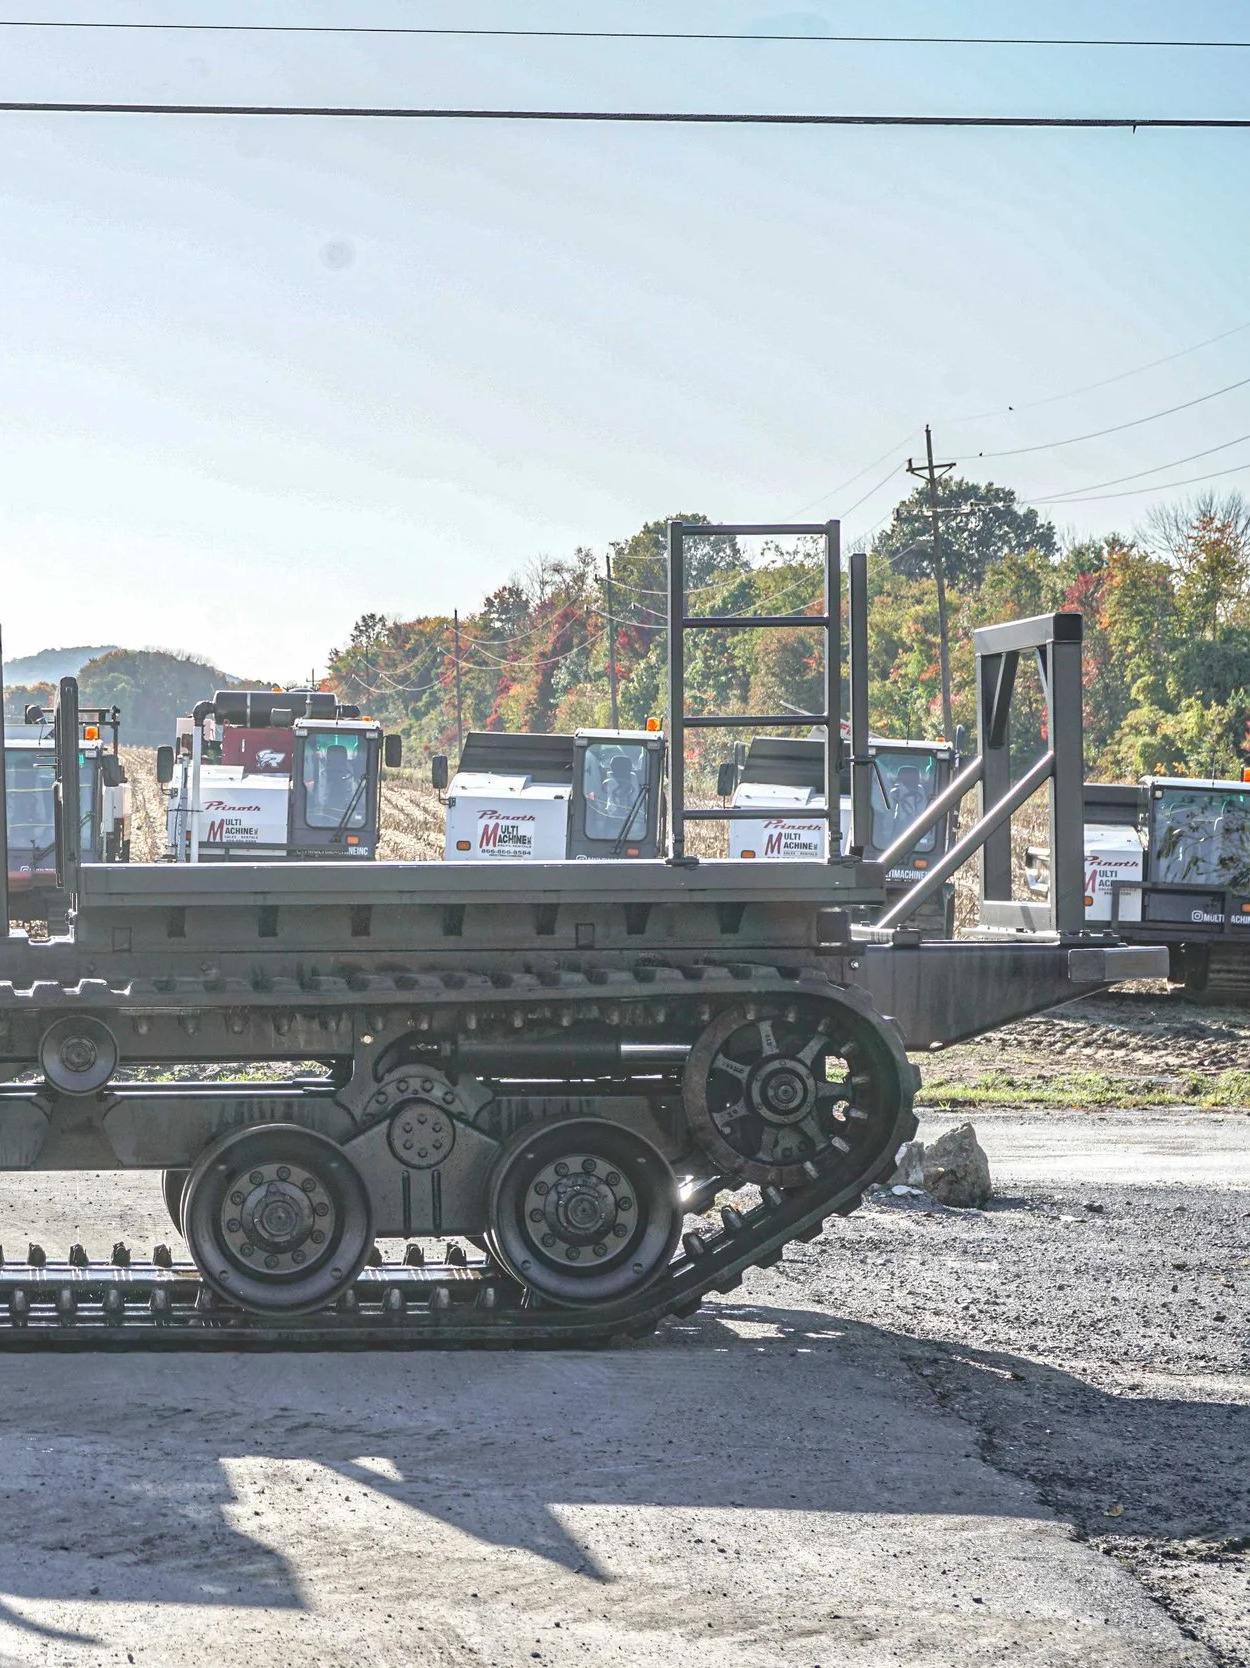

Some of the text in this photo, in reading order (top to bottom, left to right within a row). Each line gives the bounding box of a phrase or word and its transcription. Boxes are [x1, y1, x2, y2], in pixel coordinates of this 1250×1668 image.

[204, 800, 261, 811] Prinoth
[477, 809, 536, 821] Prinoth
[762, 819, 822, 831] Prinoth
